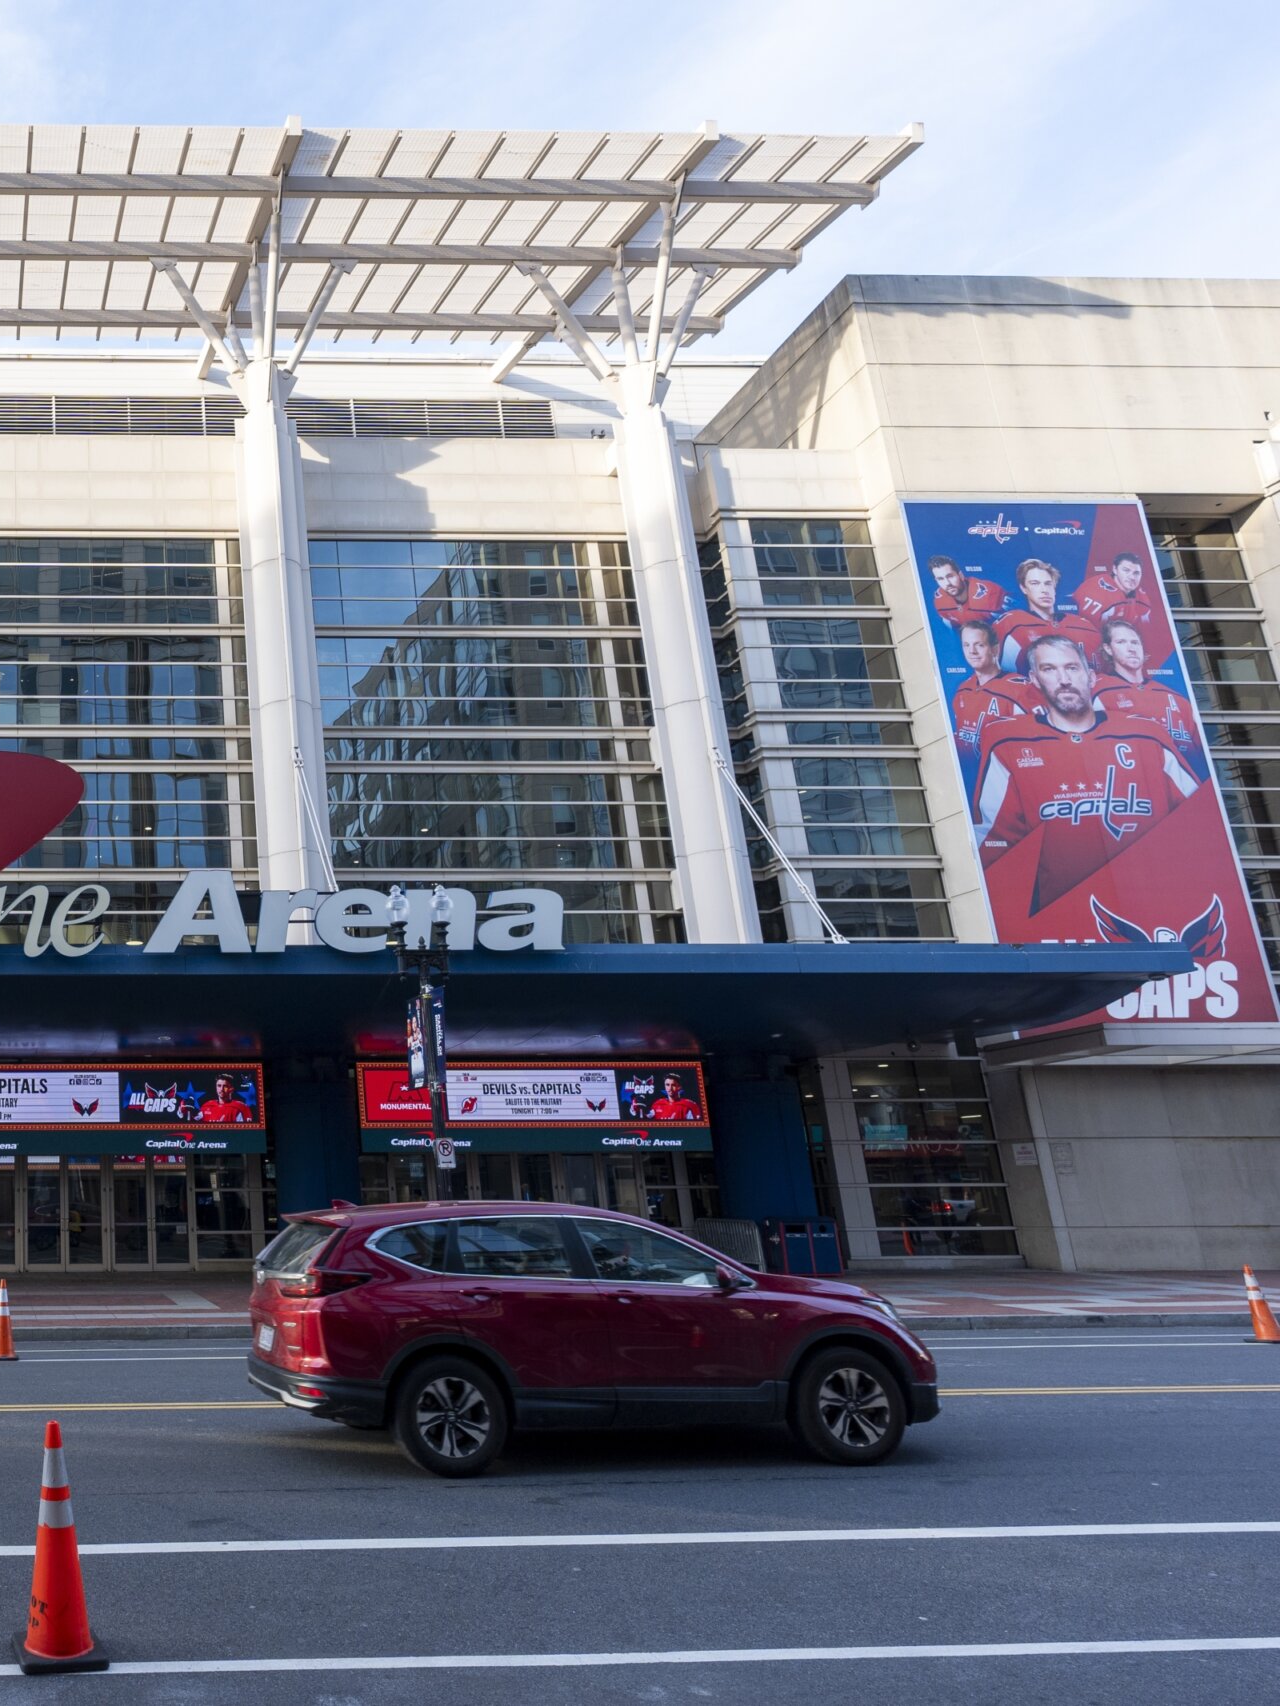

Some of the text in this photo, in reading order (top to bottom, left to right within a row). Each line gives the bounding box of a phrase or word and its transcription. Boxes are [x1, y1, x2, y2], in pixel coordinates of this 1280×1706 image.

[1083, 597, 1102, 615] 77
[987, 697, 999, 716] A
[1115, 743, 1135, 769] C
[1053, 791, 1104, 800] WASHINGTON
[1039, 765, 1152, 841] capitals
[143, 870, 566, 953] Arena
[482, 1083, 517, 1095] DEVILS
[532, 1083, 582, 1095] CAPITALS
[625, 1081, 634, 1090] ALL
[634, 1085, 655, 1094] CAPS
[129, 1093, 145, 1106] ALL
[144, 1098, 177, 1112] CAPS
[505, 1098, 562, 1106] SALUTE TO THE MILITARY
[197, 1141, 227, 1149] Arena
